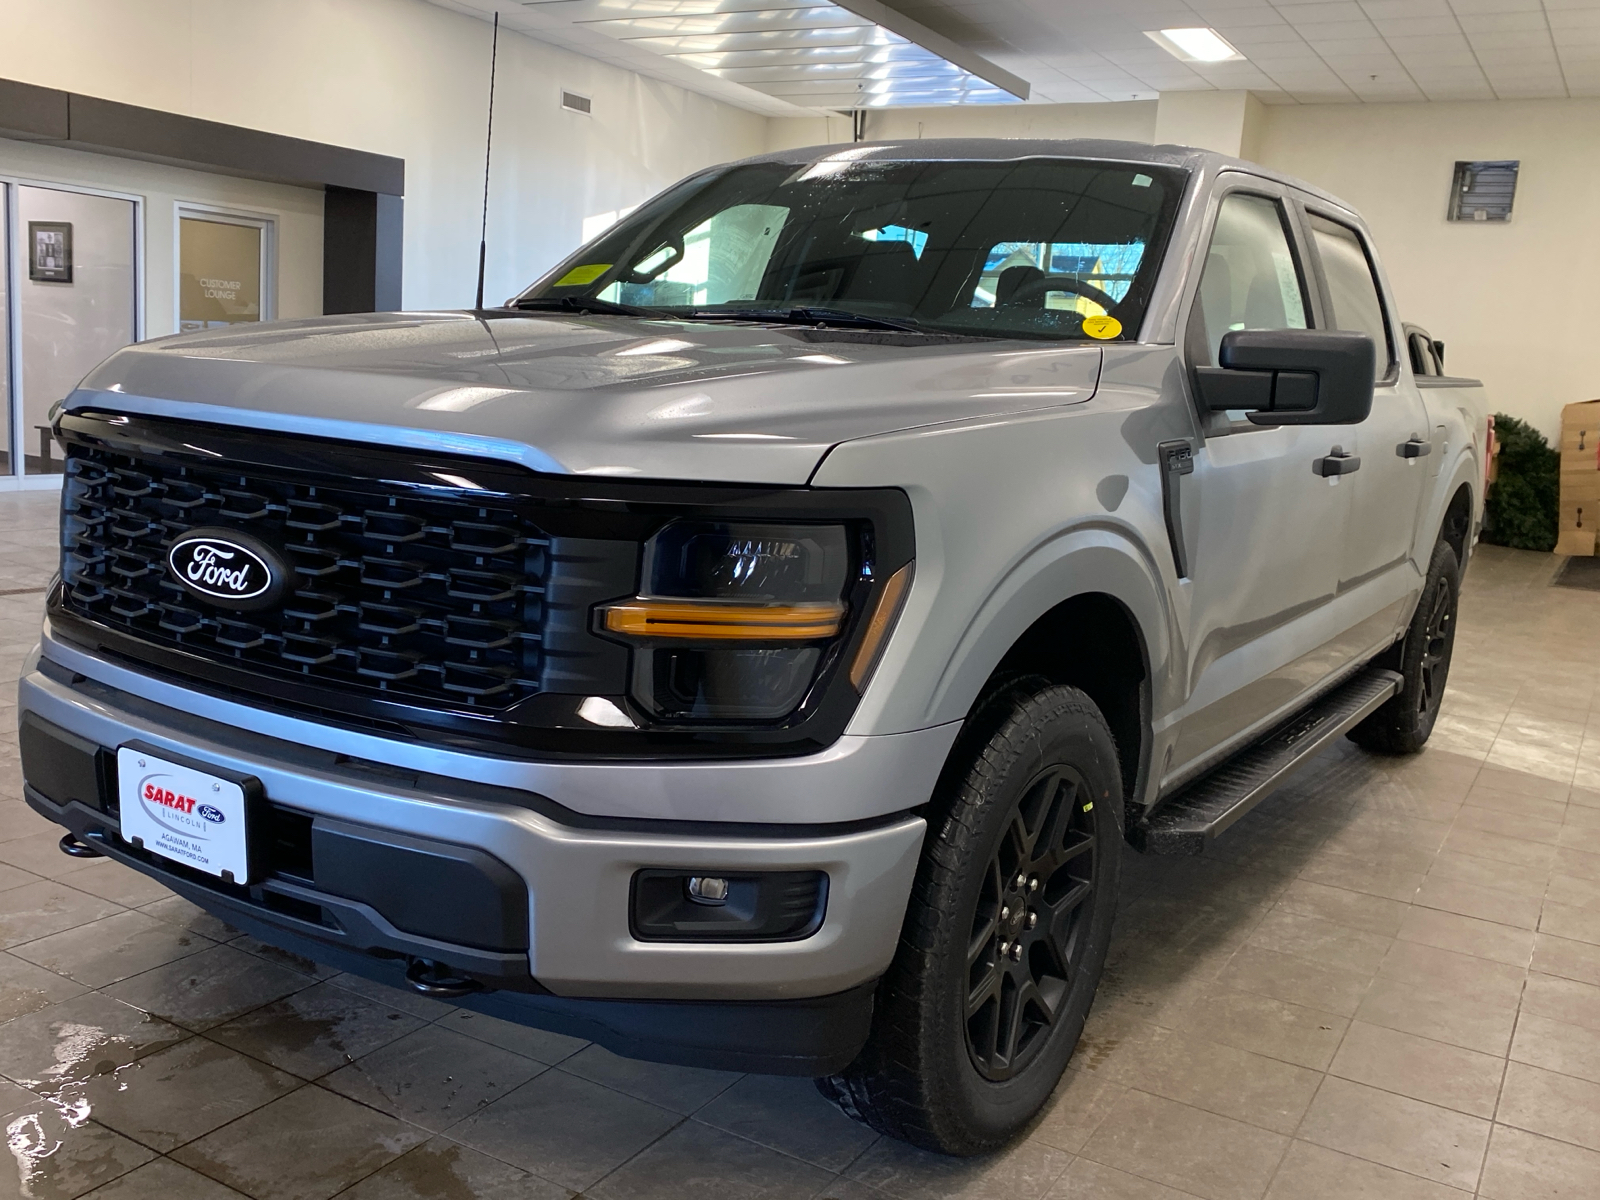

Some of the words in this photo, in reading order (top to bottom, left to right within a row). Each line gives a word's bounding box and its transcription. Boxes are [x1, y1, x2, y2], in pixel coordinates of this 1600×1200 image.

[200, 278, 241, 290] CUSTOMER
[204, 289, 236, 300] LOUNGE
[187, 545, 250, 591] Ford
[144, 783, 197, 815] SARAT
[201, 806, 221, 822] Ford
[167, 811, 201, 829] LINCOLN
[155, 840, 209, 864] WWW.SARATFORD.COM
[161, 832, 191, 850] AGAWAM,
[191, 843, 203, 853] MA
